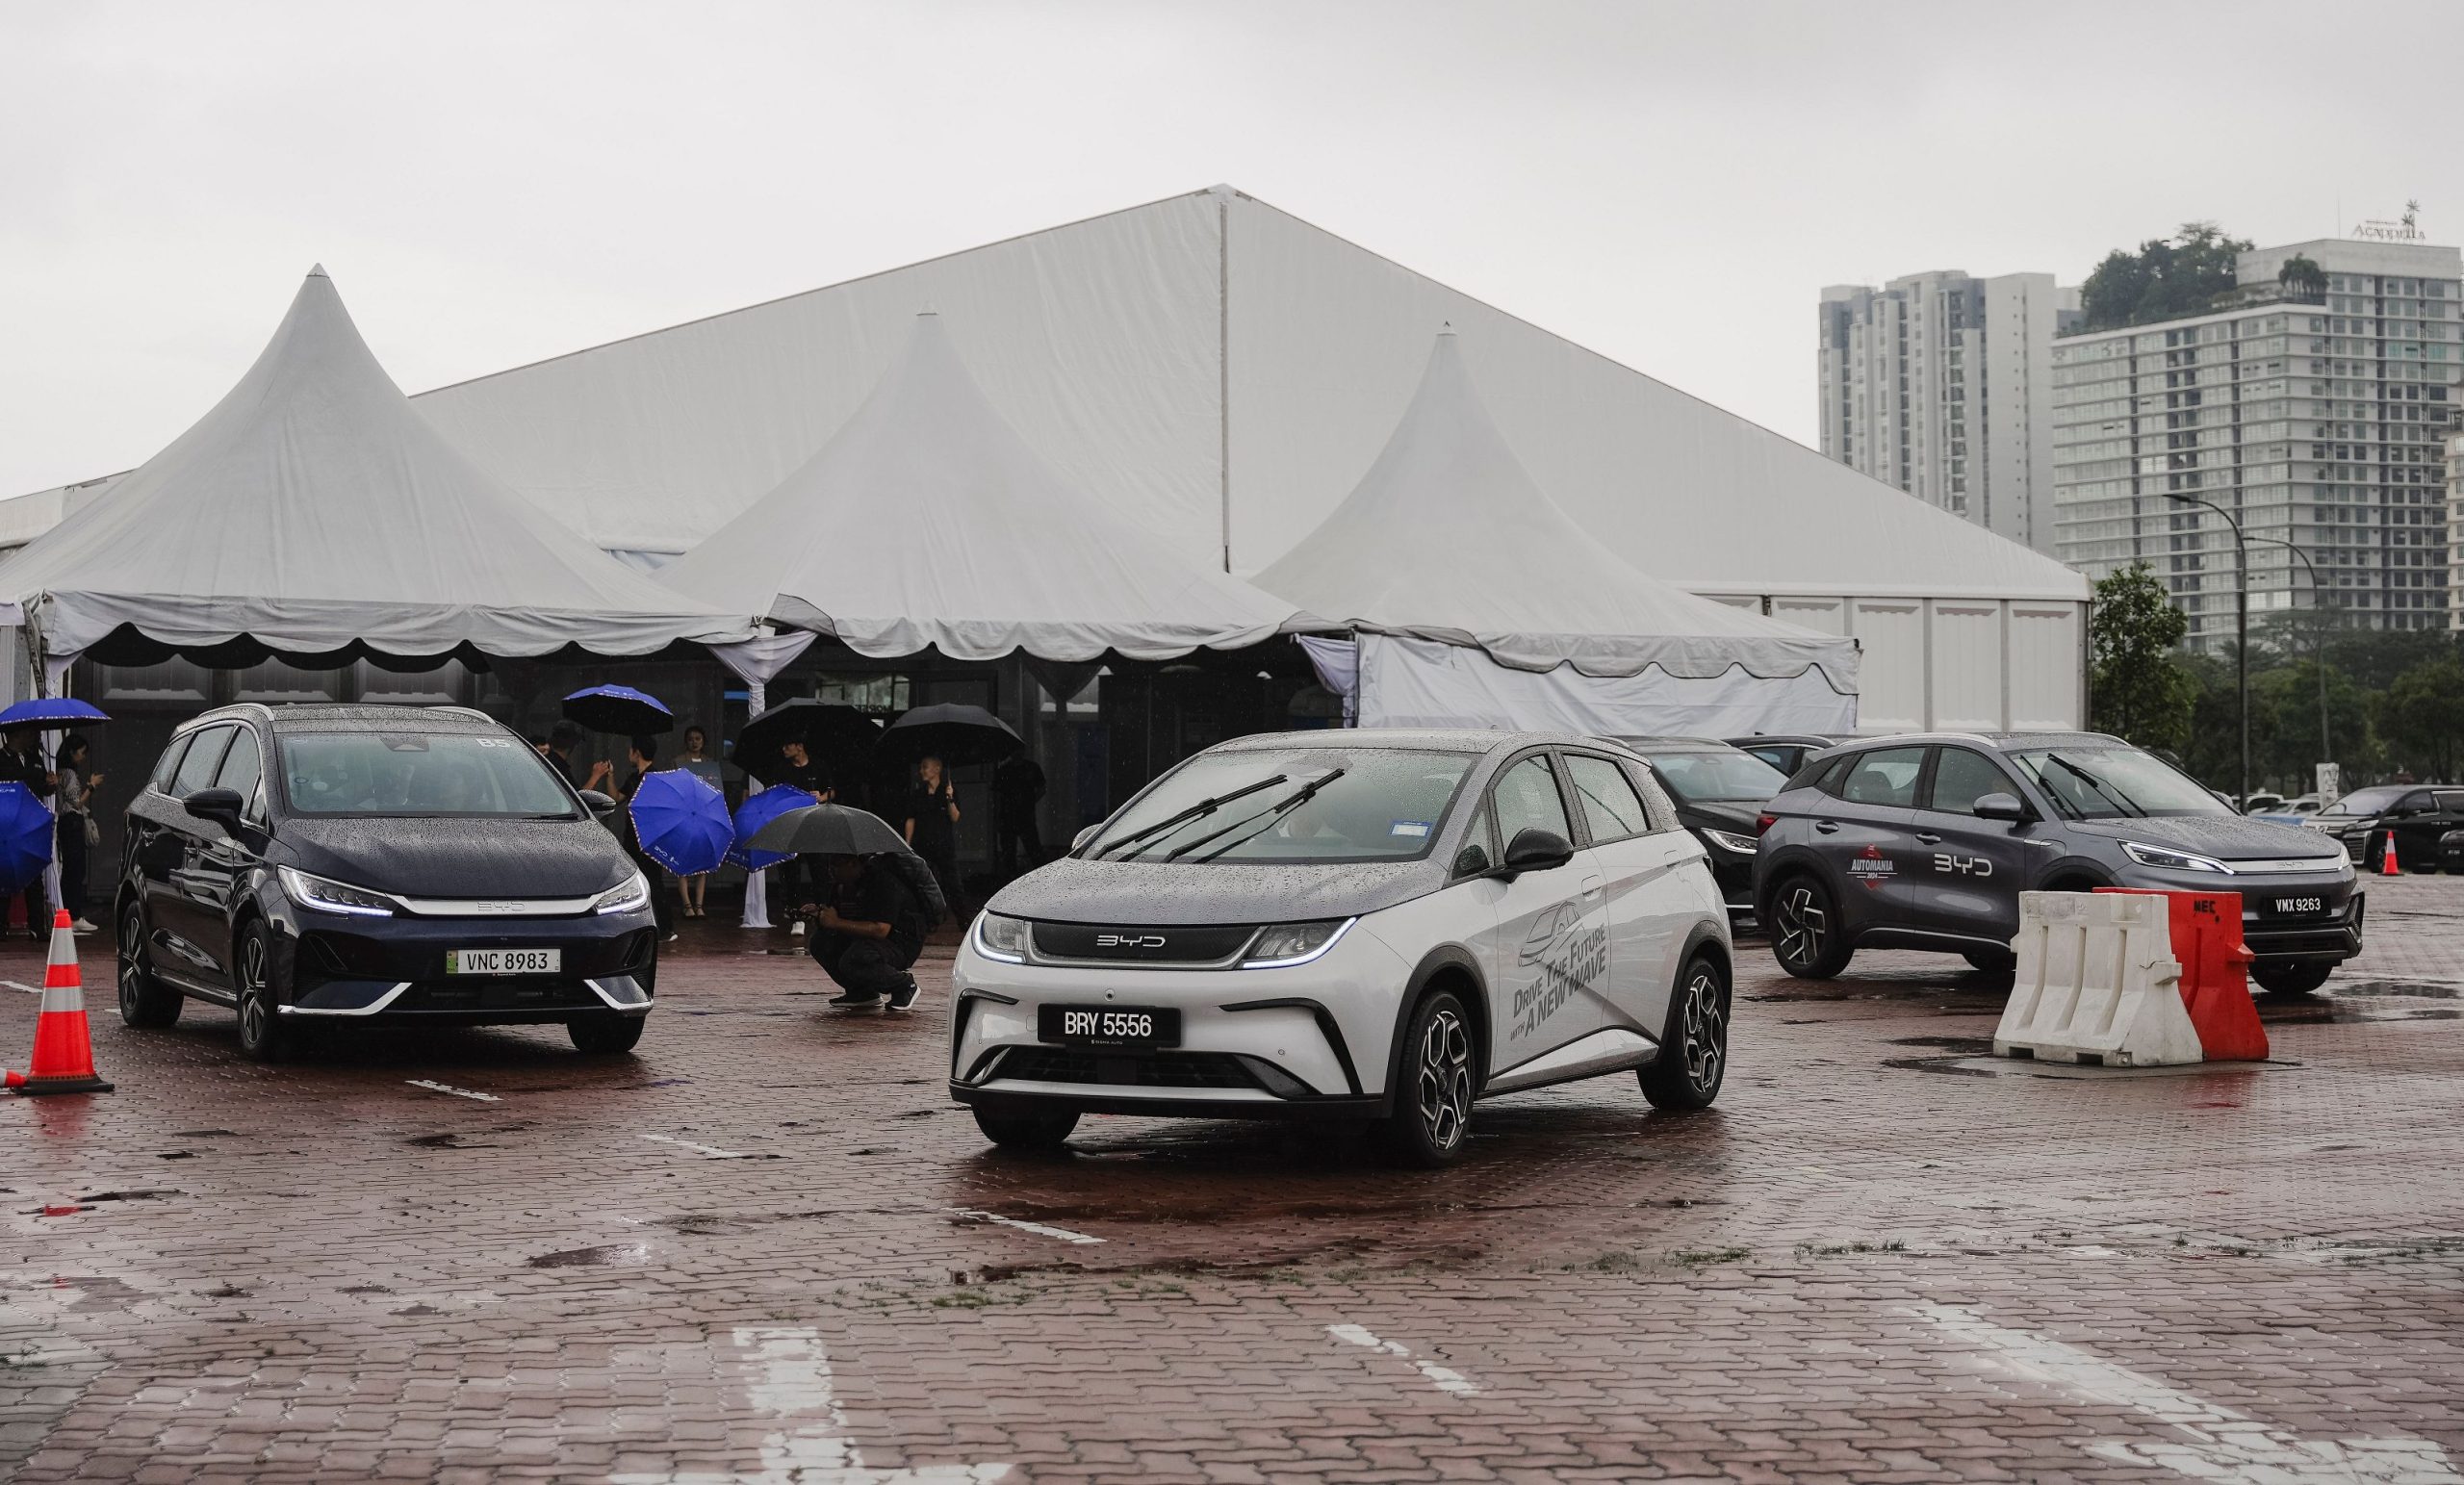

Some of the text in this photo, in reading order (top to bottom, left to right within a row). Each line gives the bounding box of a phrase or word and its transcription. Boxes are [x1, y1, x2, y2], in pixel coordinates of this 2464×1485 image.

[475, 738, 511, 748] B5
[1851, 858, 1894, 872] AUTOMANIA
[1934, 853, 1993, 878] BYD
[476, 901, 526, 912] BYD
[2275, 897, 2322, 912] VMX 9263
[1096, 935, 1167, 948] BYD
[467, 952, 549, 971] VNC 8983
[1513, 922, 1606, 1019] DRIVE THE FUTURE
[1525, 1007, 1535, 1038] A
[1537, 977, 1568, 1027] NEW
[1568, 945, 1606, 997] WAVE
[1065, 1011, 1152, 1037] BRY 5556
